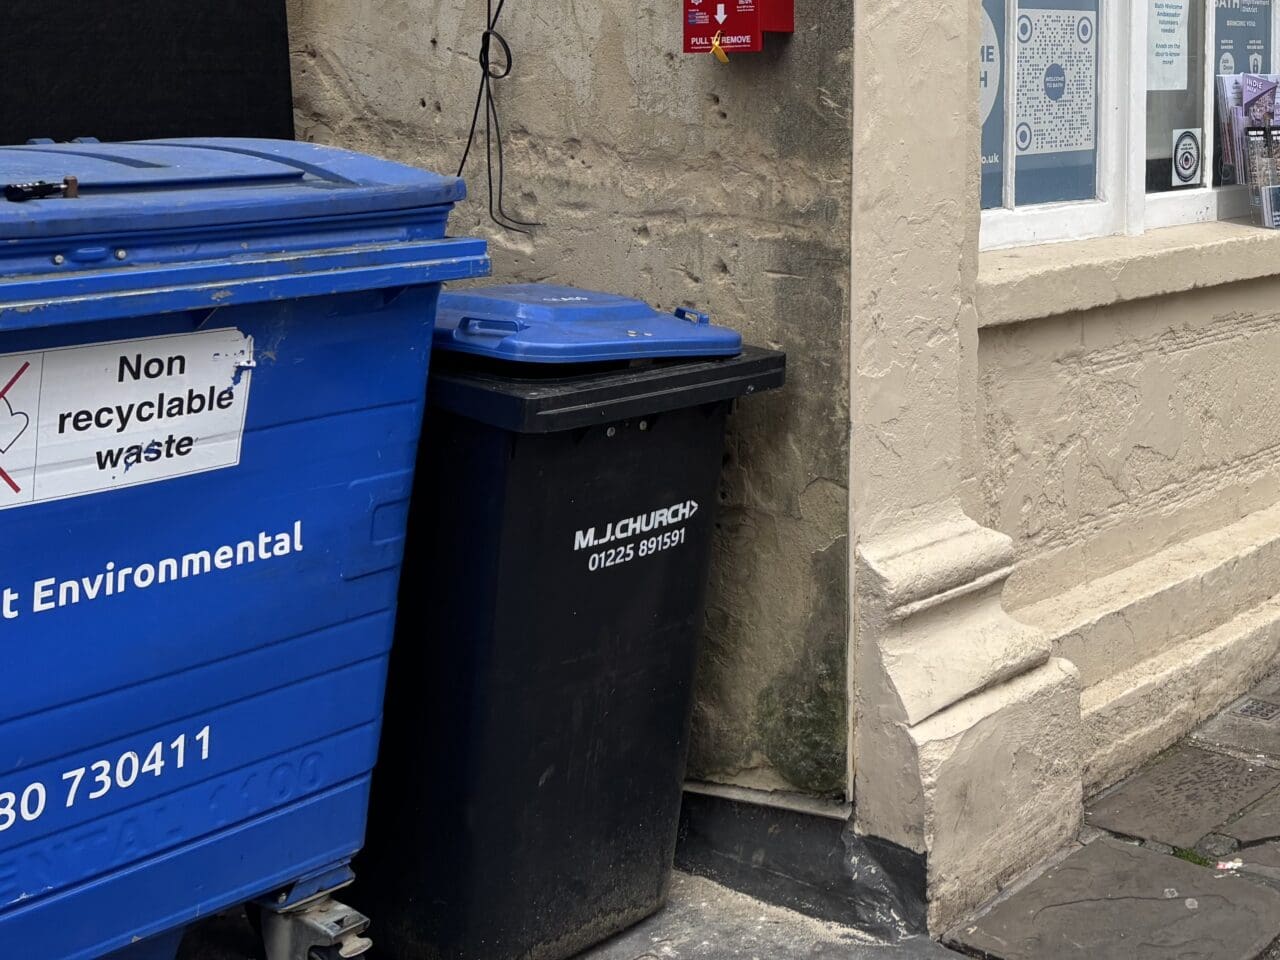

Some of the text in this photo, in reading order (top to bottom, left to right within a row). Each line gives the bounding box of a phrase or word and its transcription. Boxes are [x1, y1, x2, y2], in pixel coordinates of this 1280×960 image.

[691, 37, 709, 45] PULL
[721, 35, 752, 44] REMOVE
[117, 353, 186, 383] Non
[58, 385, 235, 434] recyclable
[95, 434, 195, 471] waste
[32, 520, 304, 613] Environmental
[588, 527, 686, 572] 01225 891591
[61, 725, 211, 808] 730411
